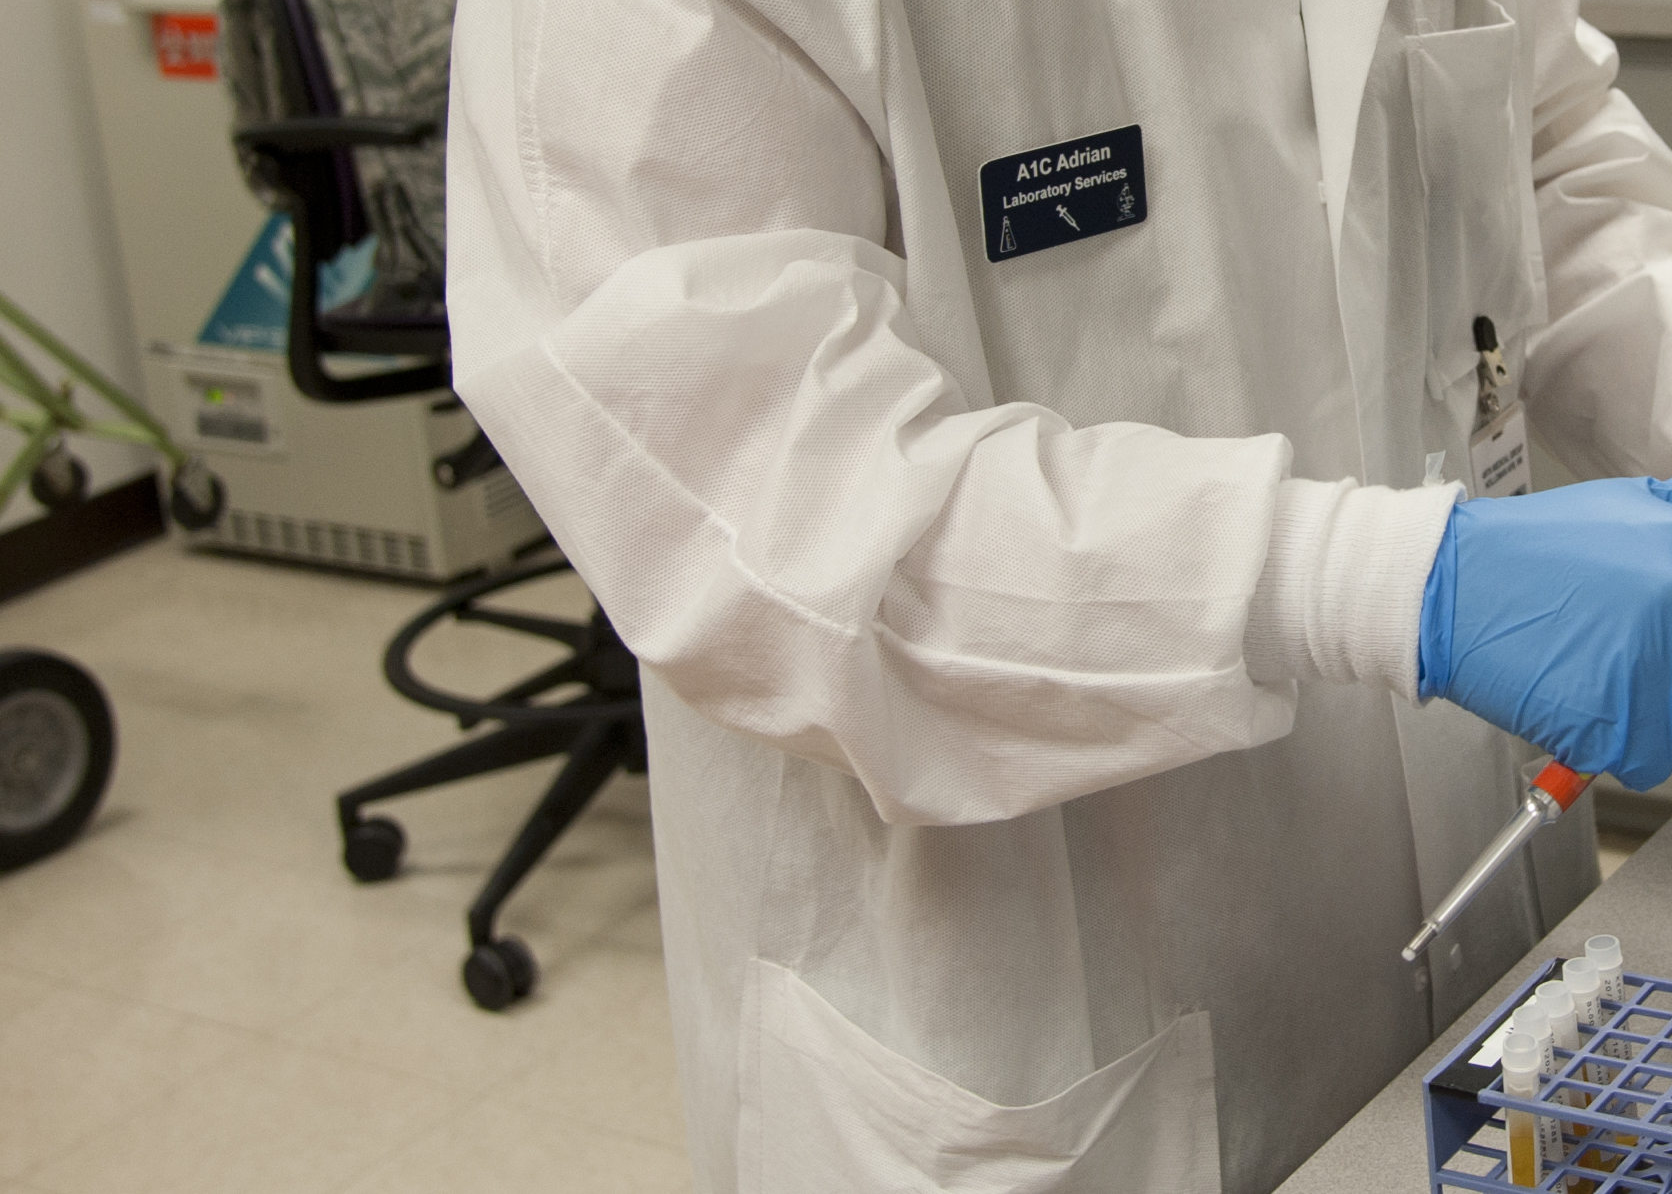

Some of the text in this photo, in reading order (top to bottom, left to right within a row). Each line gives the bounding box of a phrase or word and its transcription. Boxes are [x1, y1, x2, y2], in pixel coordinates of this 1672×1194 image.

[1016, 145, 1111, 183] A1C Adrian
[1003, 167, 1128, 210] Laboratory Services
